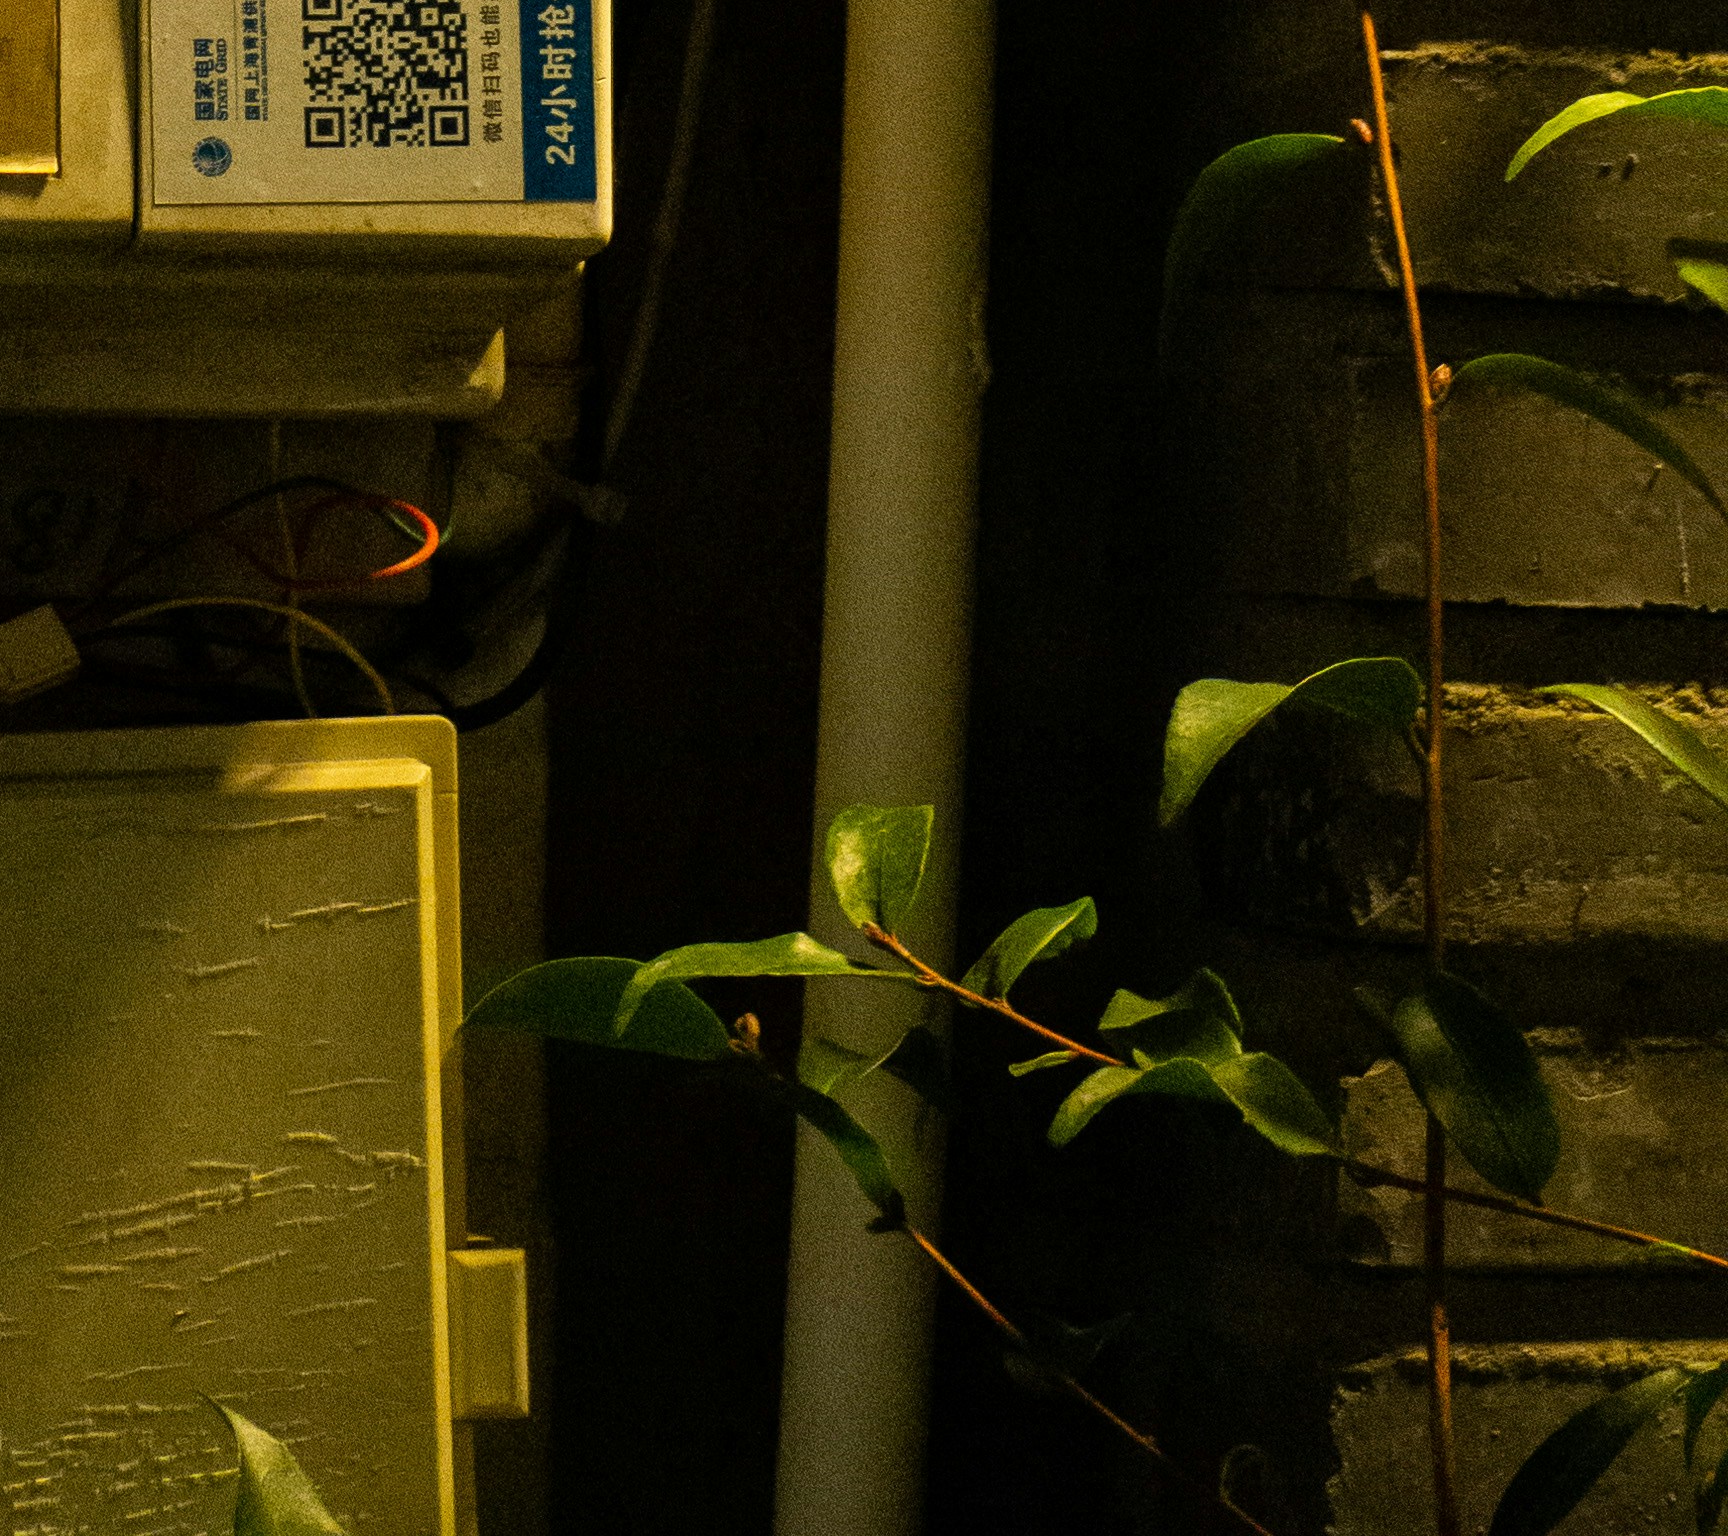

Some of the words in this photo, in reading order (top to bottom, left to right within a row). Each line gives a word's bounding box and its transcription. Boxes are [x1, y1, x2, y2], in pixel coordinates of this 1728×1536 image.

[214, 38, 227, 74] GRID
[193, 39, 214, 121] 国家电网
[216, 78, 229, 121] STATE
